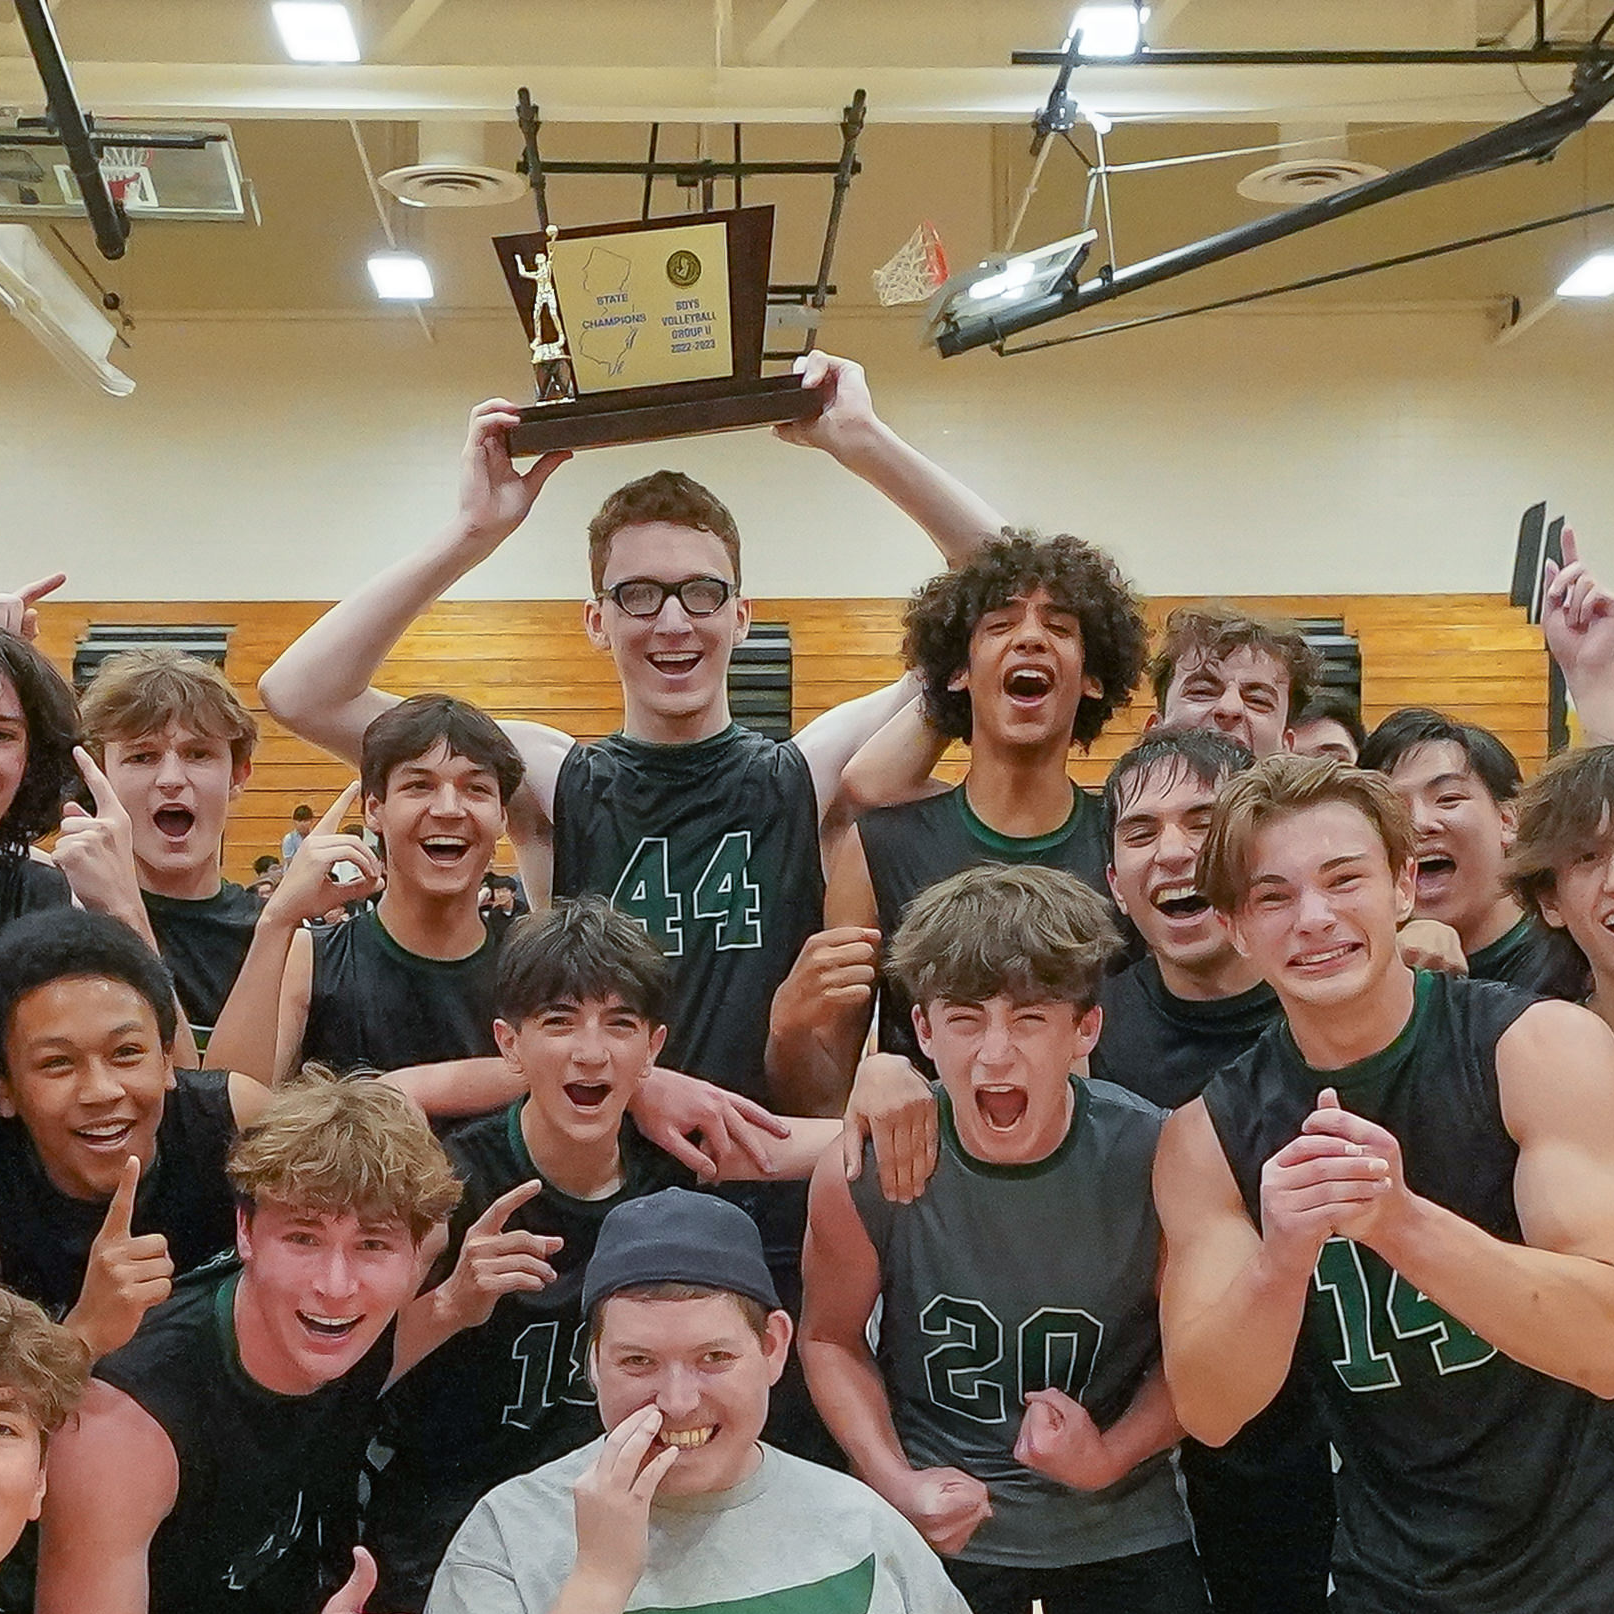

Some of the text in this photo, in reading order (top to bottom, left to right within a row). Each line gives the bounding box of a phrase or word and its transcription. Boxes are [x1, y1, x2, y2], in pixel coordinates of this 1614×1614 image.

[596, 293, 629, 306] STATE
[675, 298, 701, 311] BOYS
[582, 313, 647, 330] CHAMPIONS
[661, 311, 718, 327] VOLLEYBALL
[671, 326, 703, 340] GROUP
[609, 830, 763, 958] 44
[919, 1292, 1105, 1425] 20
